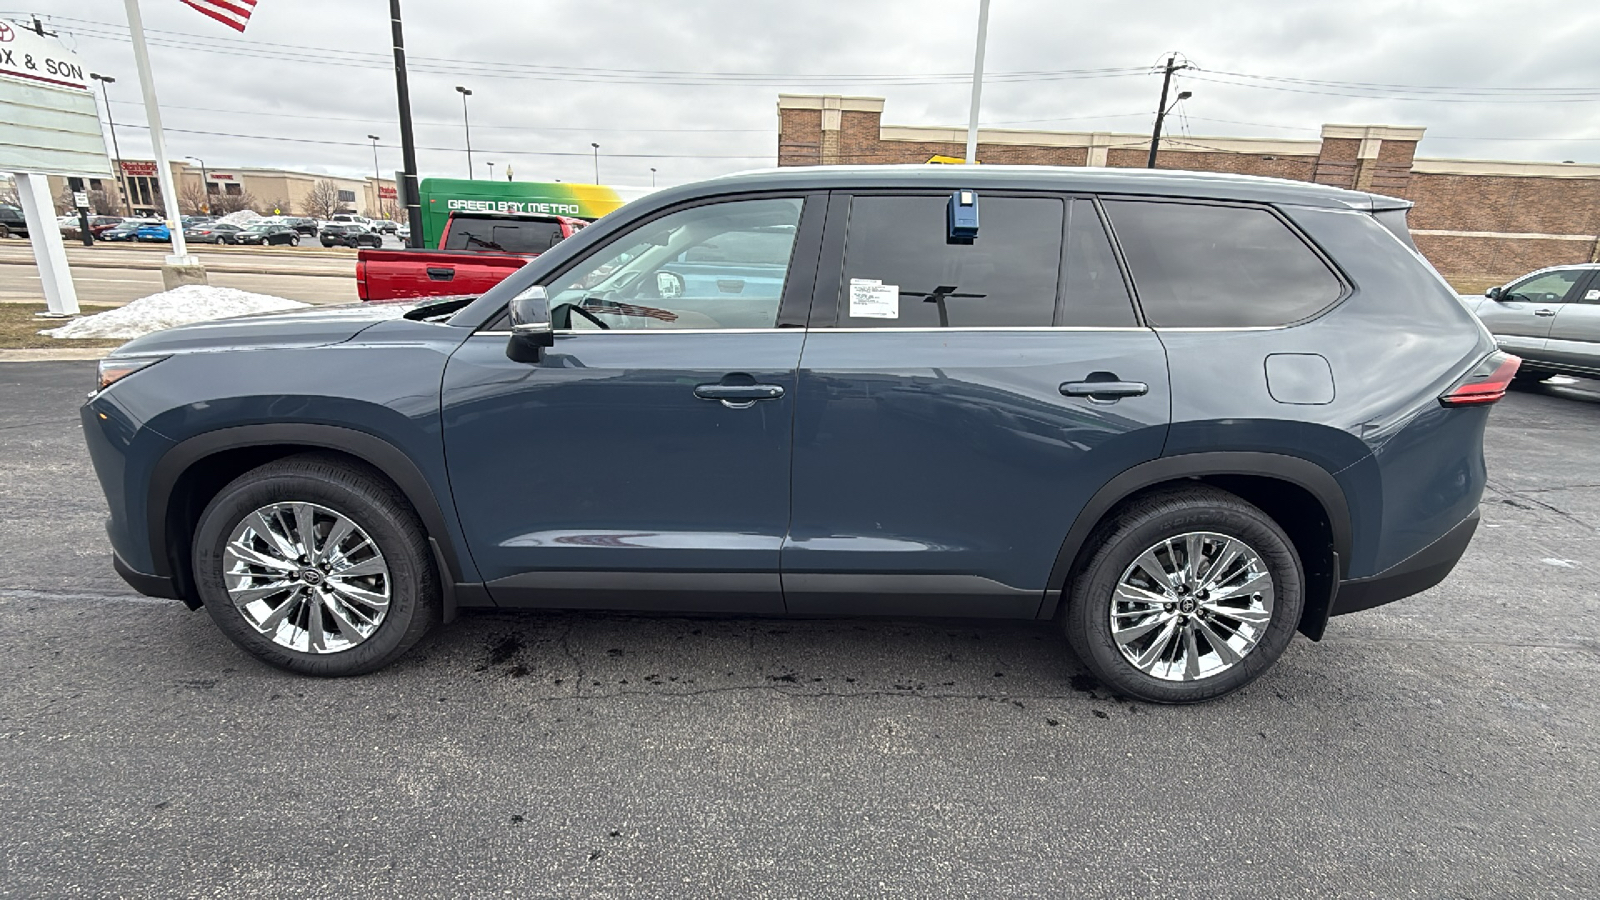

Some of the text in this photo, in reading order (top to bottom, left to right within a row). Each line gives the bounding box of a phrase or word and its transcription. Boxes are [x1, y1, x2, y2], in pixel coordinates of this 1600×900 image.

[25, 54, 38, 71] &
[45, 58, 83, 80] SON
[448, 199, 495, 210] GREEN
[528, 202, 579, 214] METRO
